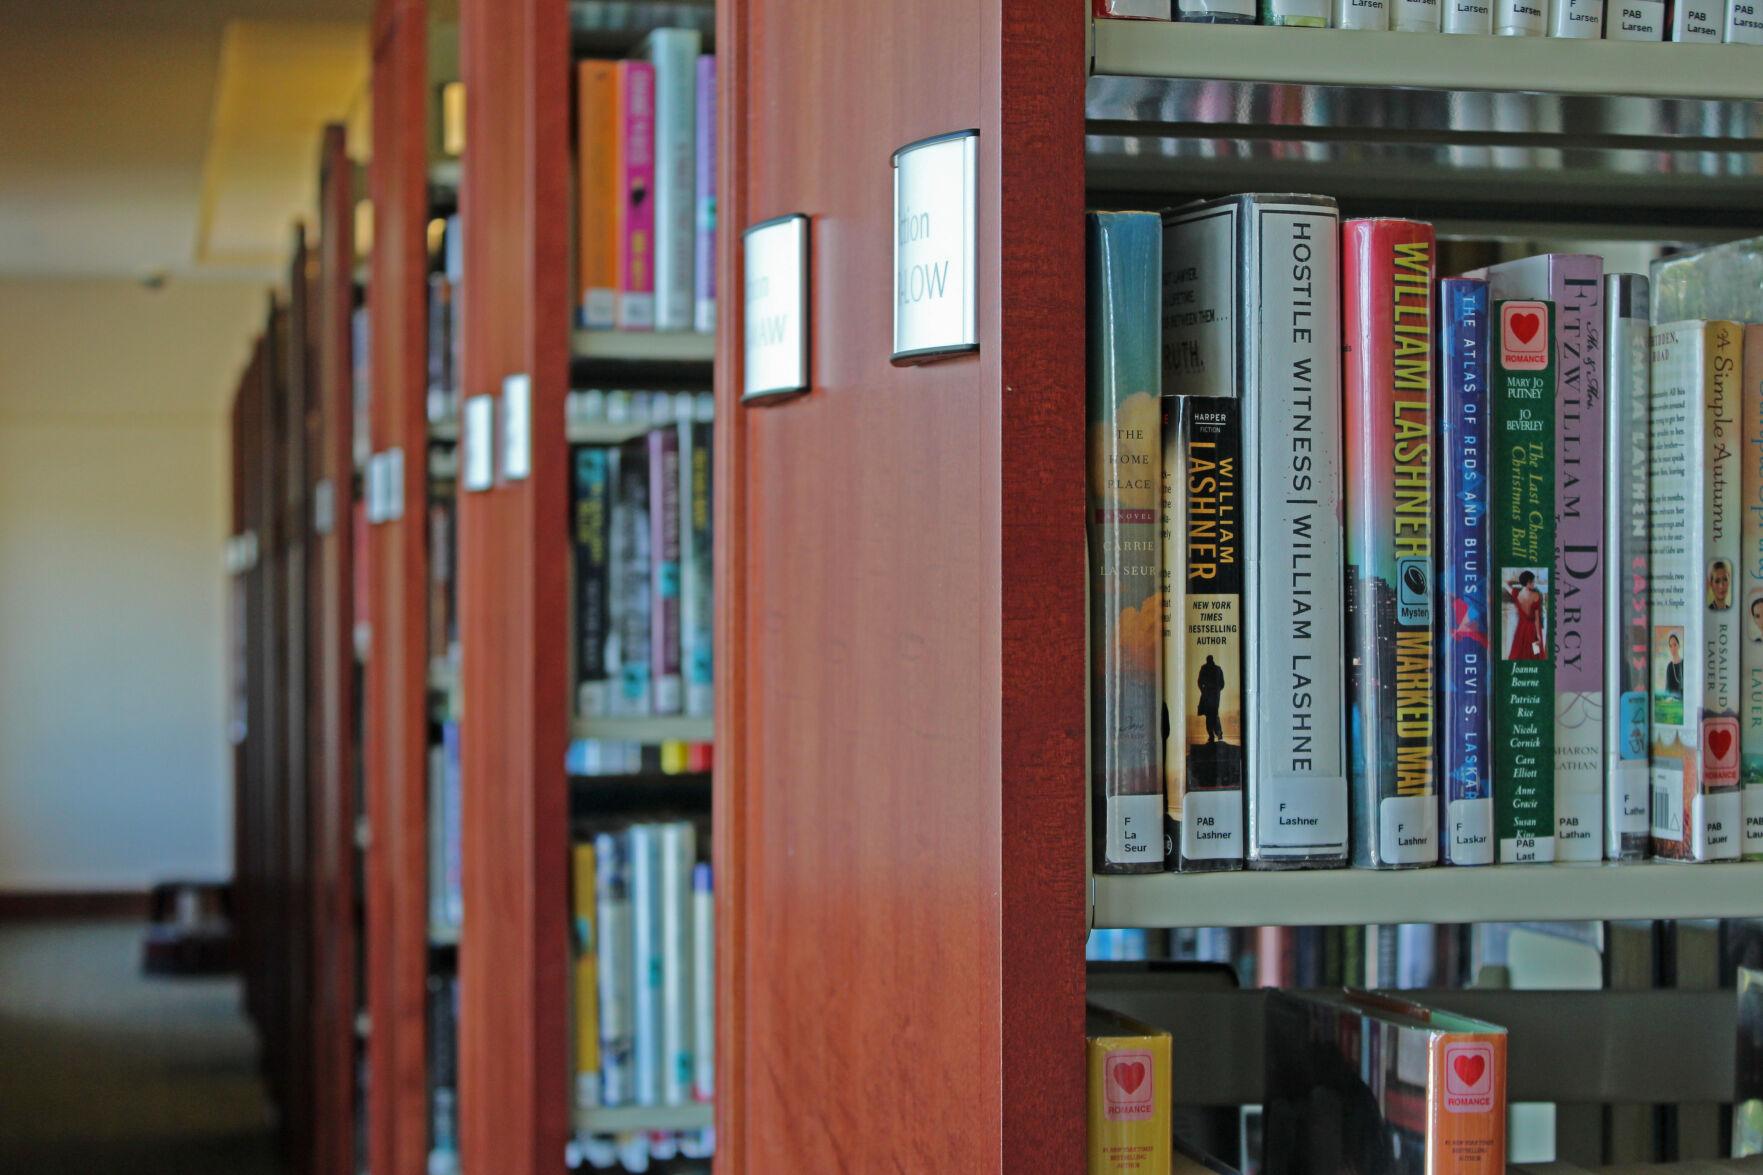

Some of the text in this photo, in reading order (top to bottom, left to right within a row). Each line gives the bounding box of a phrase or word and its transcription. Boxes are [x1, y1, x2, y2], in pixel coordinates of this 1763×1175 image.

[1352, 0, 1383, 9] Larsen
[1457, 3, 1488, 14] Larsen
[1734, 4, 1754, 15] PAB
[1513, 4, 1541, 17] Larsen
[1623, 9, 1642, 19] PAB
[1688, 11, 1706, 21] PAB
[1569, 12, 1599, 23] Larsen
[1733, 17, 1763, 29] Larsso
[1622, 21, 1653, 33] Larsen
[1687, 24, 1716, 36] Larsen
[901, 260, 949, 304] LOW
[1163, 339, 1204, 370] RUTH.
[1505, 355, 1545, 363] ROMANCE
[1507, 376, 1544, 388] MARY JO
[1507, 388, 1543, 399] PUTNEY
[1394, 242, 1431, 559] WILLIAM LASHNER
[1194, 413, 1227, 422] HARPER
[1519, 409, 1532, 421] JO
[1506, 420, 1544, 432] BEVERLEY
[1117, 429, 1144, 440] THE
[1707, 328, 1734, 543] A Simple Autumn
[1563, 274, 1599, 672] FITZWILLIAM DARCY
[1107, 479, 1151, 489] PLACE
[1632, 432, 1647, 537] LATHEN
[1292, 222, 1312, 771] HOSTILE WITNESS WILLIAM LASHNE
[1511, 446, 1527, 558] Christmas Ball
[1528, 442, 1544, 563] The Last Chance
[1189, 442, 1217, 580] LASHNER
[1219, 457, 1234, 564] WILLIAM
[1103, 541, 1154, 552] CARRIE
[1463, 295, 1478, 800] THE ATLAS OF REDS AND BLUES DEVI S. LASKAR
[1100, 566, 1157, 576] LA SEUR
[1192, 601, 1231, 609] NEW YORK
[1200, 613, 1223, 621] TIMES
[1401, 607, 1429, 618] Mystery
[1189, 624, 1237, 633] BESTSELLING
[1196, 636, 1227, 645] AUTHOR
[1511, 662, 1538, 675] Joanna
[1707, 641, 1716, 691] LAUER
[1718, 624, 1728, 708] ROSALIND
[1396, 631, 1433, 738] MARKED
[1511, 676, 1540, 688] Bourne
[1510, 694, 1540, 704] Patricia
[1751, 668, 1763, 729] LAUER
[1517, 707, 1534, 718] Rice
[1512, 724, 1538, 735] Nicola
[1509, 737, 1540, 749] Cornick
[1554, 745, 1600, 756] HARON
[1515, 754, 1535, 765] Cara
[1513, 768, 1537, 779] Elliott
[1704, 770, 1736, 779] ROMANCE
[1515, 785, 1536, 796] Anne
[1512, 798, 1538, 809] Gracie
[1624, 794, 1630, 803] F
[1279, 803, 1286, 812] F
[1124, 817, 1131, 826] F
[1196, 817, 1215, 826] PAB
[1279, 816, 1319, 826] Lashner
[1513, 816, 1537, 827] Susan
[1559, 818, 1579, 826] PAB
[1398, 824, 1404, 832] F
[1456, 823, 1462, 831] F
[1707, 822, 1722, 832] PAB
[1124, 830, 1137, 840] La
[1196, 830, 1232, 840] Lashner
[1456, 835, 1487, 844] Laskar
[1559, 830, 1591, 839] Lathan
[1746, 830, 1763, 839] Lau
[1516, 838, 1535, 848] PAB
[1707, 836, 1728, 845] Lauer
[1124, 843, 1147, 852] Seur
[1516, 852, 1535, 861] Last
[1448, 1097, 1490, 1106] ROMANCE
[1108, 1104, 1151, 1114] ROMANCE
